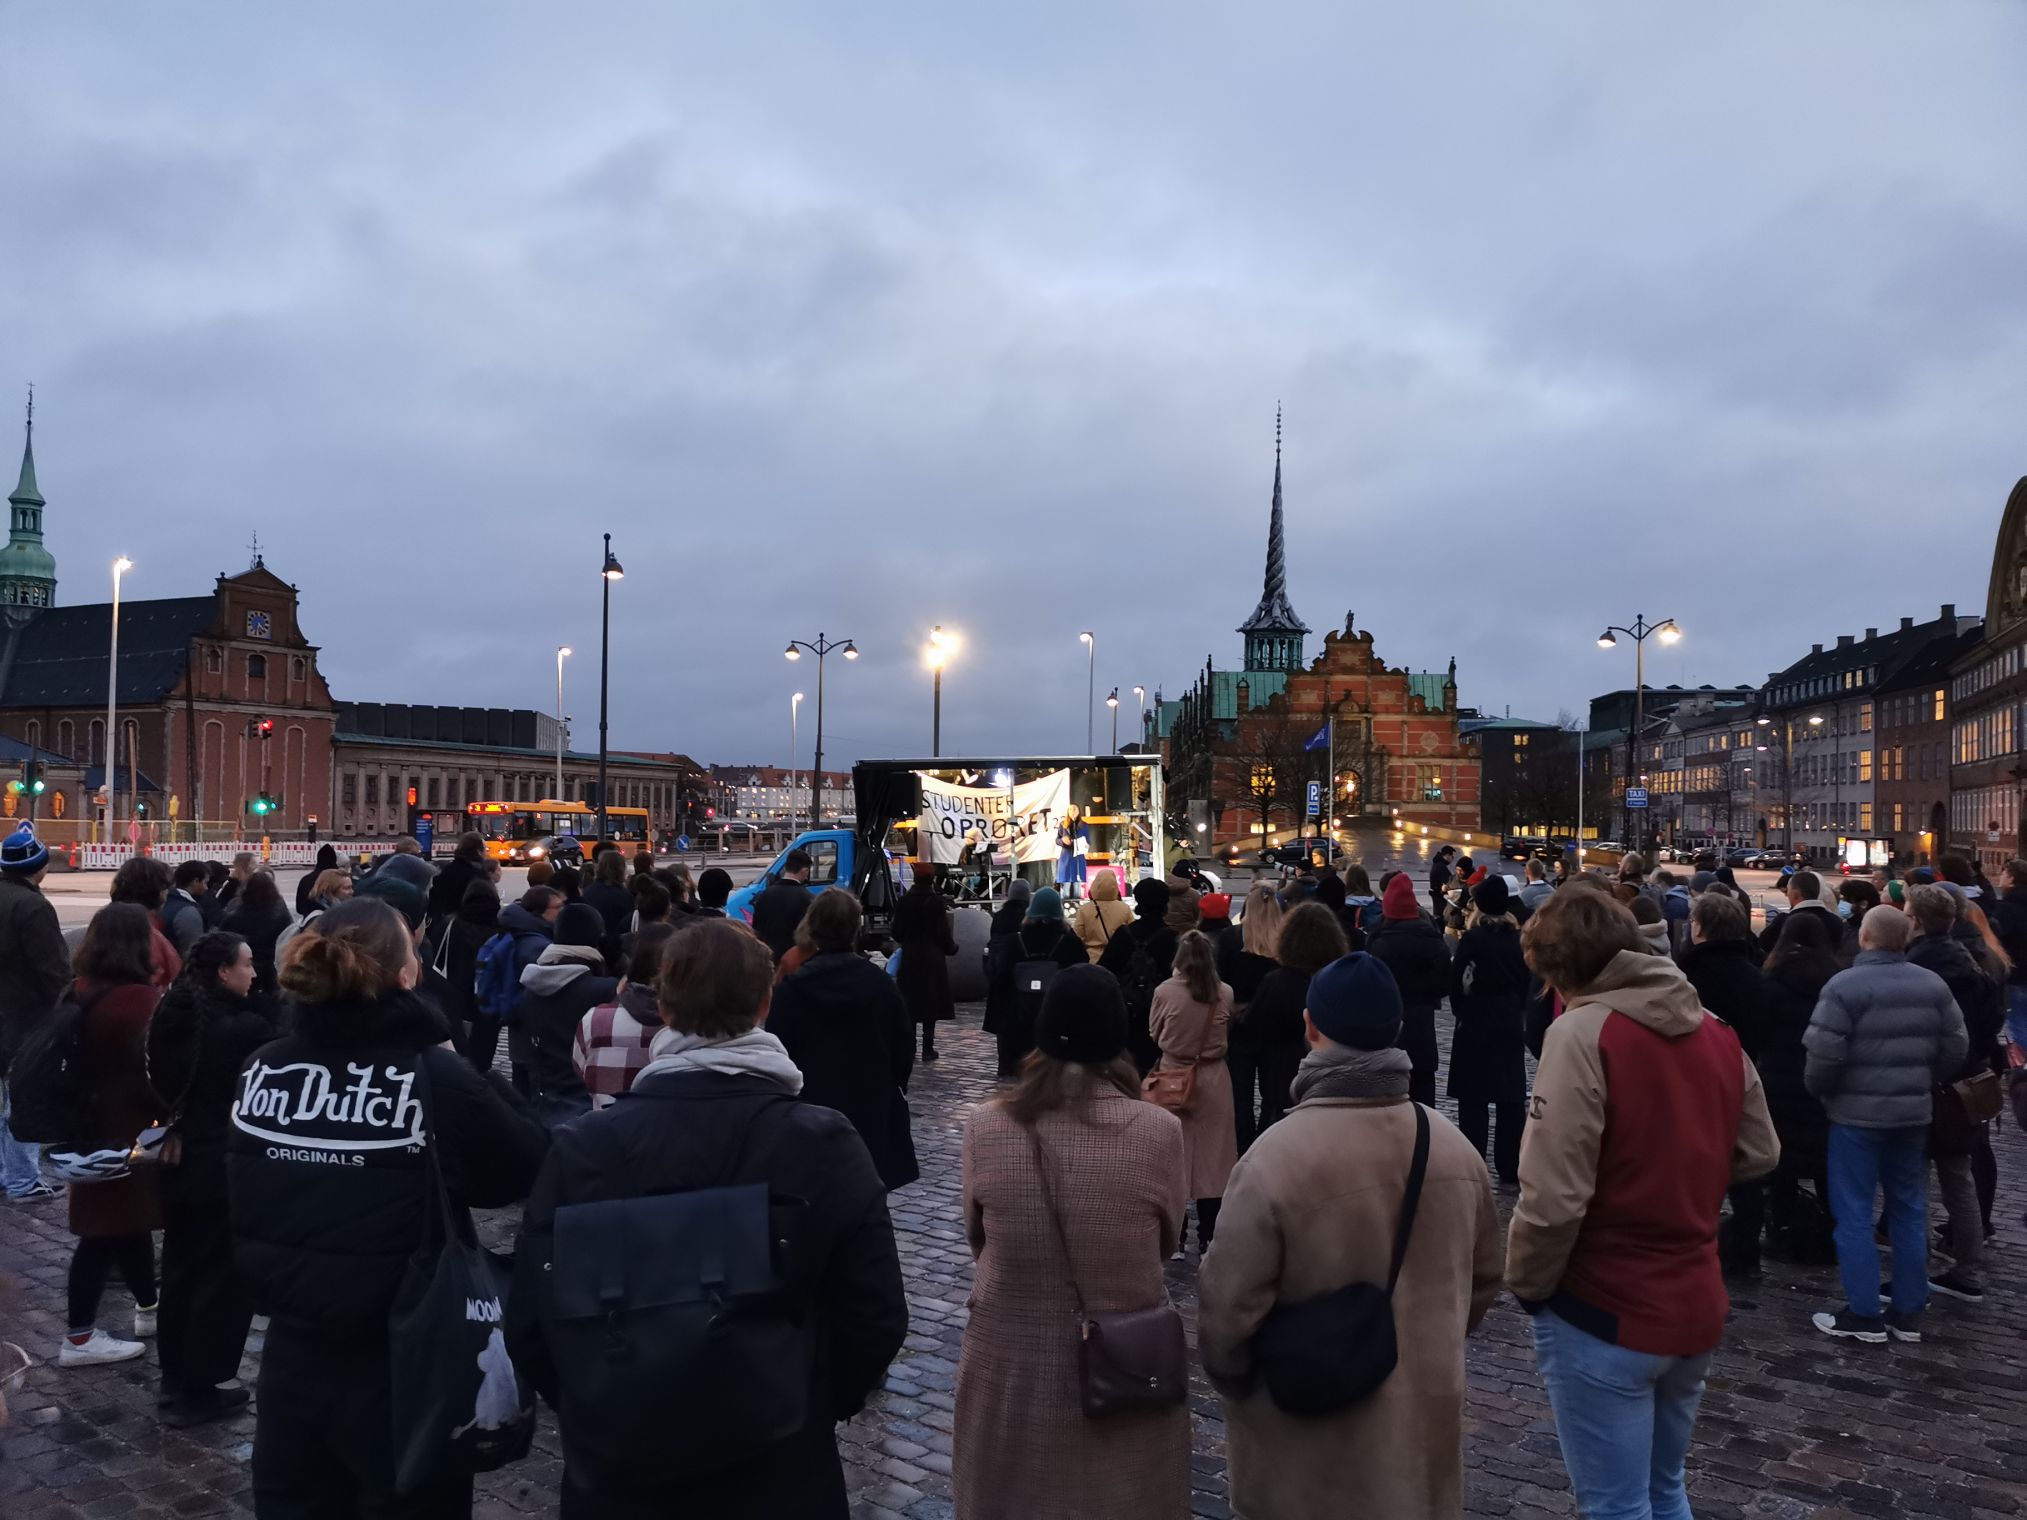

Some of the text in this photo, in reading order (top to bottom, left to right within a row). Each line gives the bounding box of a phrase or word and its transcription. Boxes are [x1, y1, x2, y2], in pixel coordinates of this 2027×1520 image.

[1628, 790, 1645, 798] TAXI
[239, 1058, 426, 1134] Von Dutch
[266, 1147, 365, 1167] ORIGINALS
[406, 1146, 421, 1154] TM
